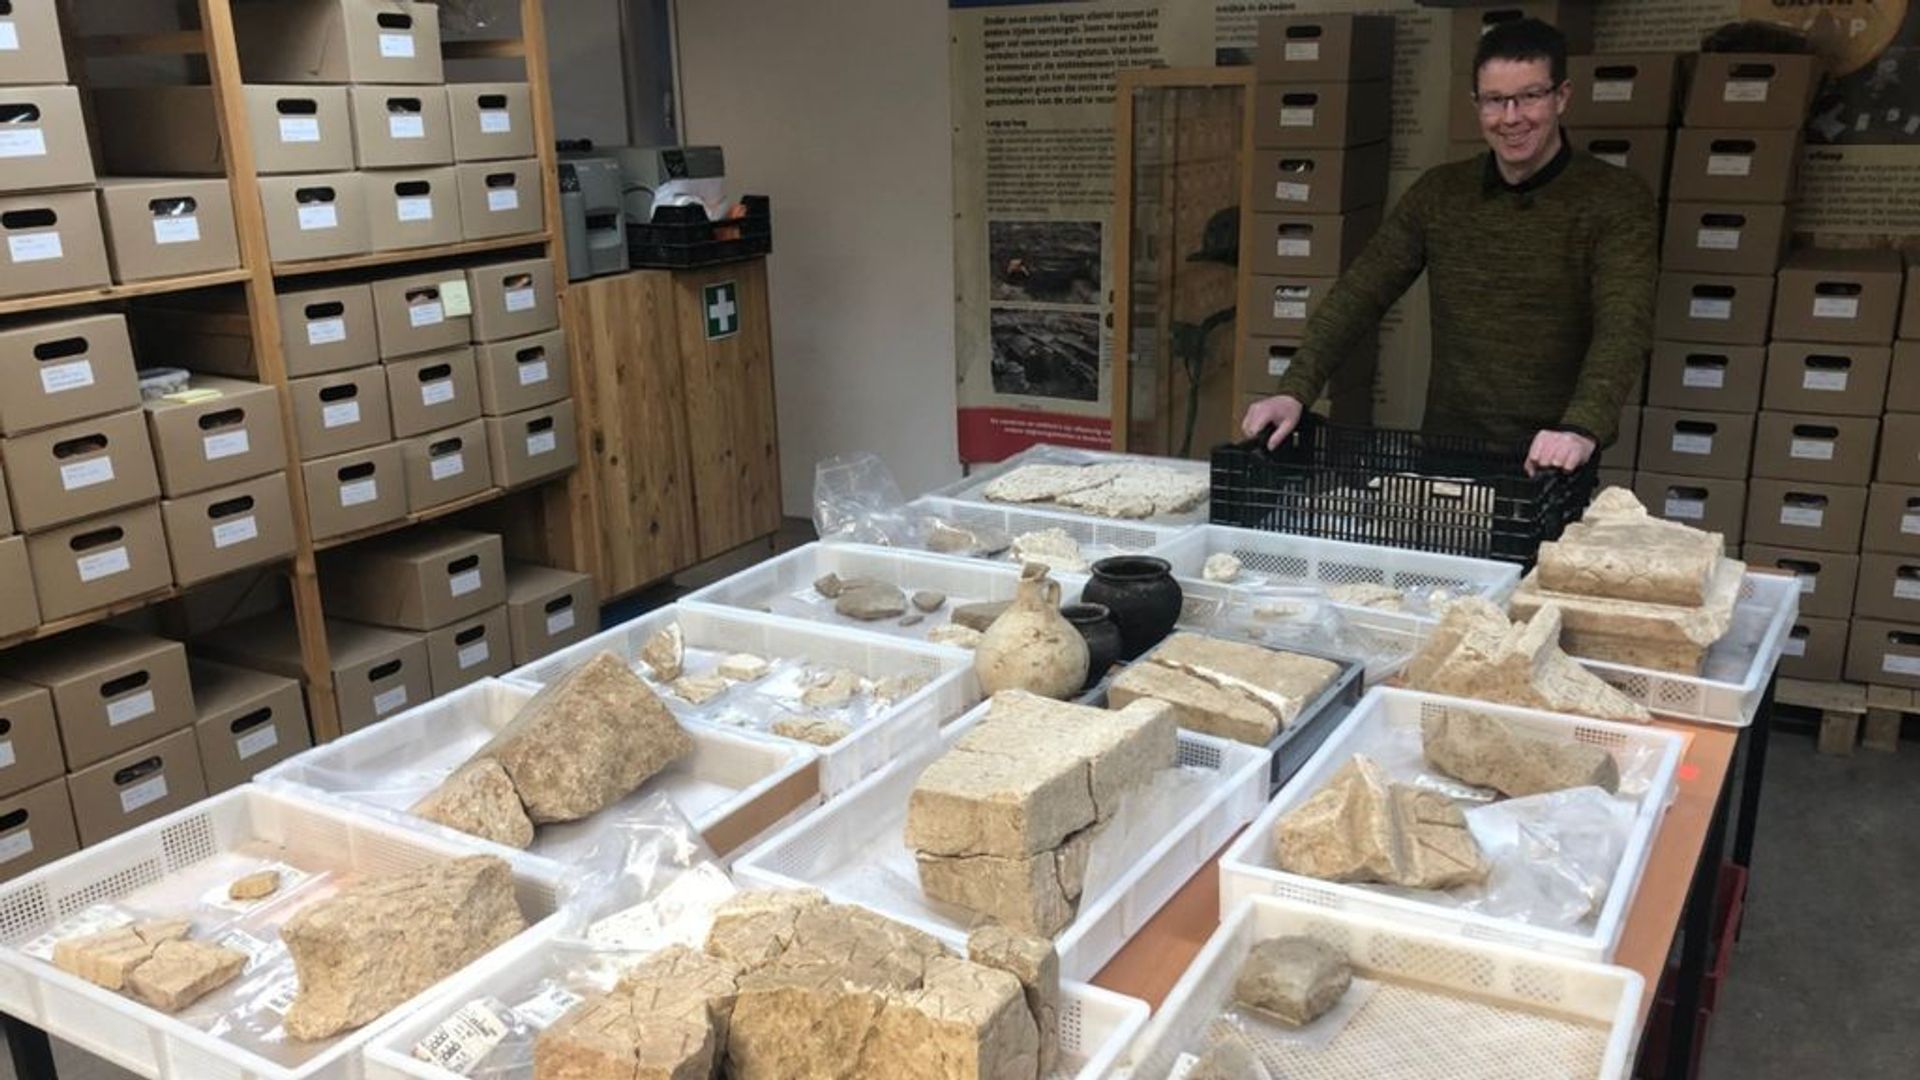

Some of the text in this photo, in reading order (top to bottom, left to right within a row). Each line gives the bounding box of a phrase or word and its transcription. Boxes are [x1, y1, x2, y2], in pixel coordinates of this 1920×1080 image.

[1059, 12, 1084, 24] liggen
[1146, 8, 1159, 17] uit
[1071, 36, 1083, 44] die
[1139, 33, 1154, 42] het
[1020, 50, 1050, 58] hebben
[1032, 61, 1042, 69] uit
[1044, 61, 1054, 69] de
[1038, 72, 1049, 81] uit
[1051, 71, 1065, 80] het
[1067, 71, 1097, 80] recente
[1035, 84, 1063, 96] graven
[1064, 83, 1075, 92] die
[1036, 97, 1052, 106] van
[1054, 96, 1064, 105] de
